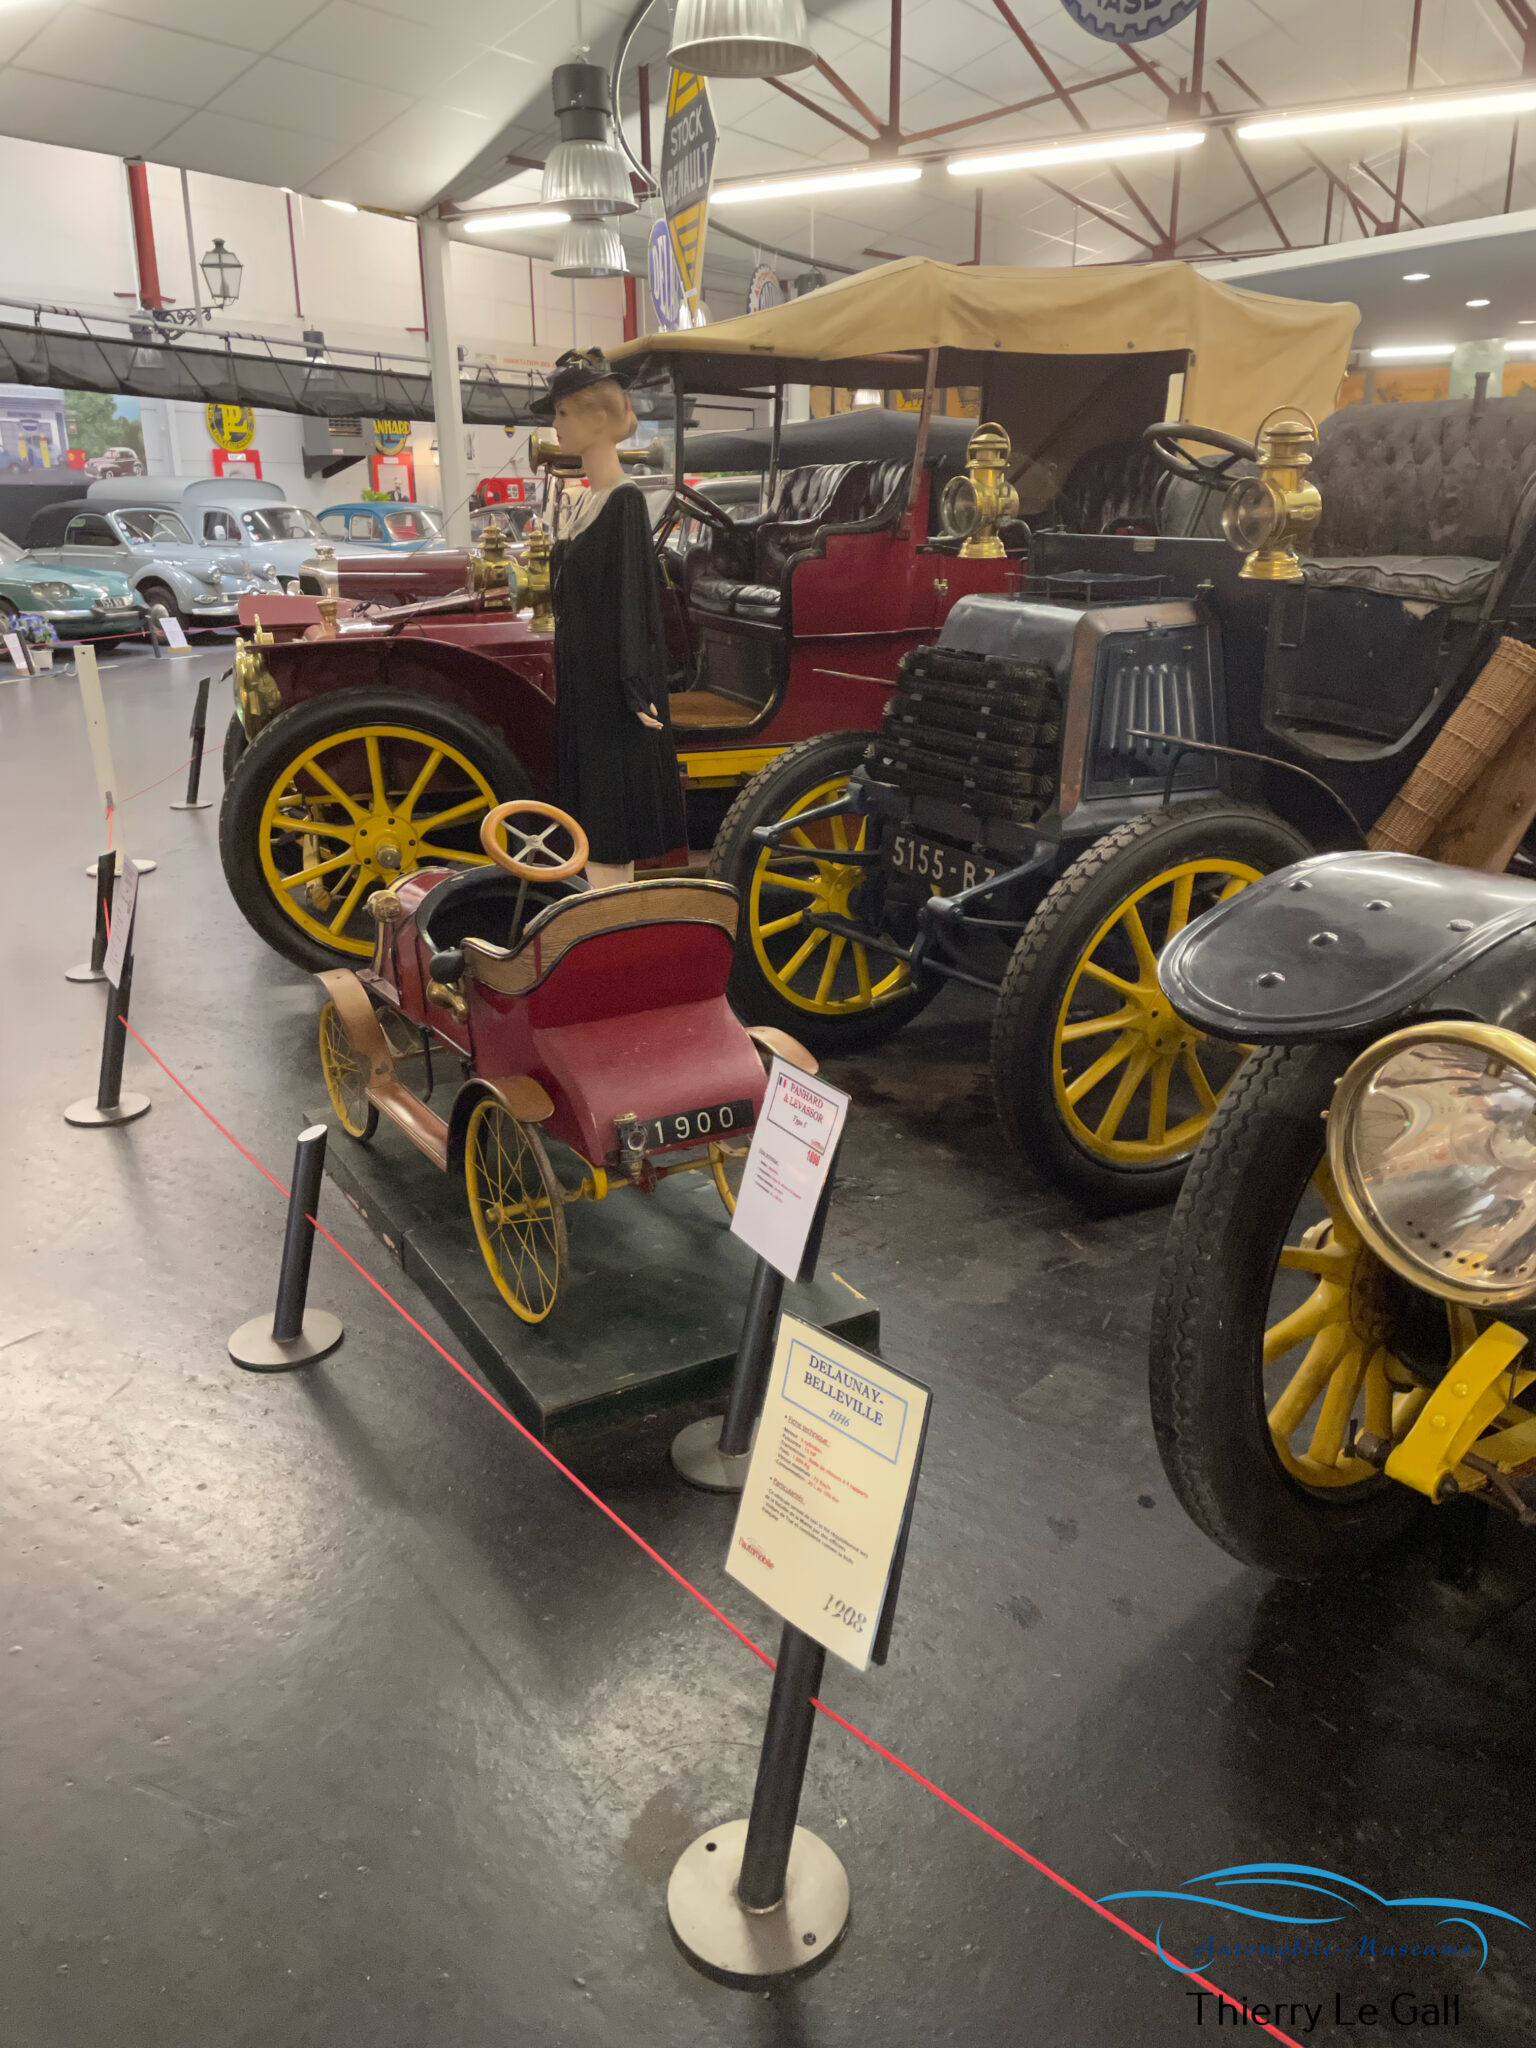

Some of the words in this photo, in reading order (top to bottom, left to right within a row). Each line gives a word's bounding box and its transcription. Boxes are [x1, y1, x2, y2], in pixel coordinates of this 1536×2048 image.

[671, 104, 703, 156] STOCK
[666, 141, 709, 209] RENAULT
[789, 1096, 823, 1124] LEVASSOR
[790, 1083, 824, 1109] PANHARD
[654, 1106, 734, 1144] 1900
[804, 1371, 883, 1426] BELLEVILLE
[809, 1354, 884, 1405] DELAUNAY-
[829, 1409, 851, 1427] HH6
[822, 1593, 867, 1633] 1908
